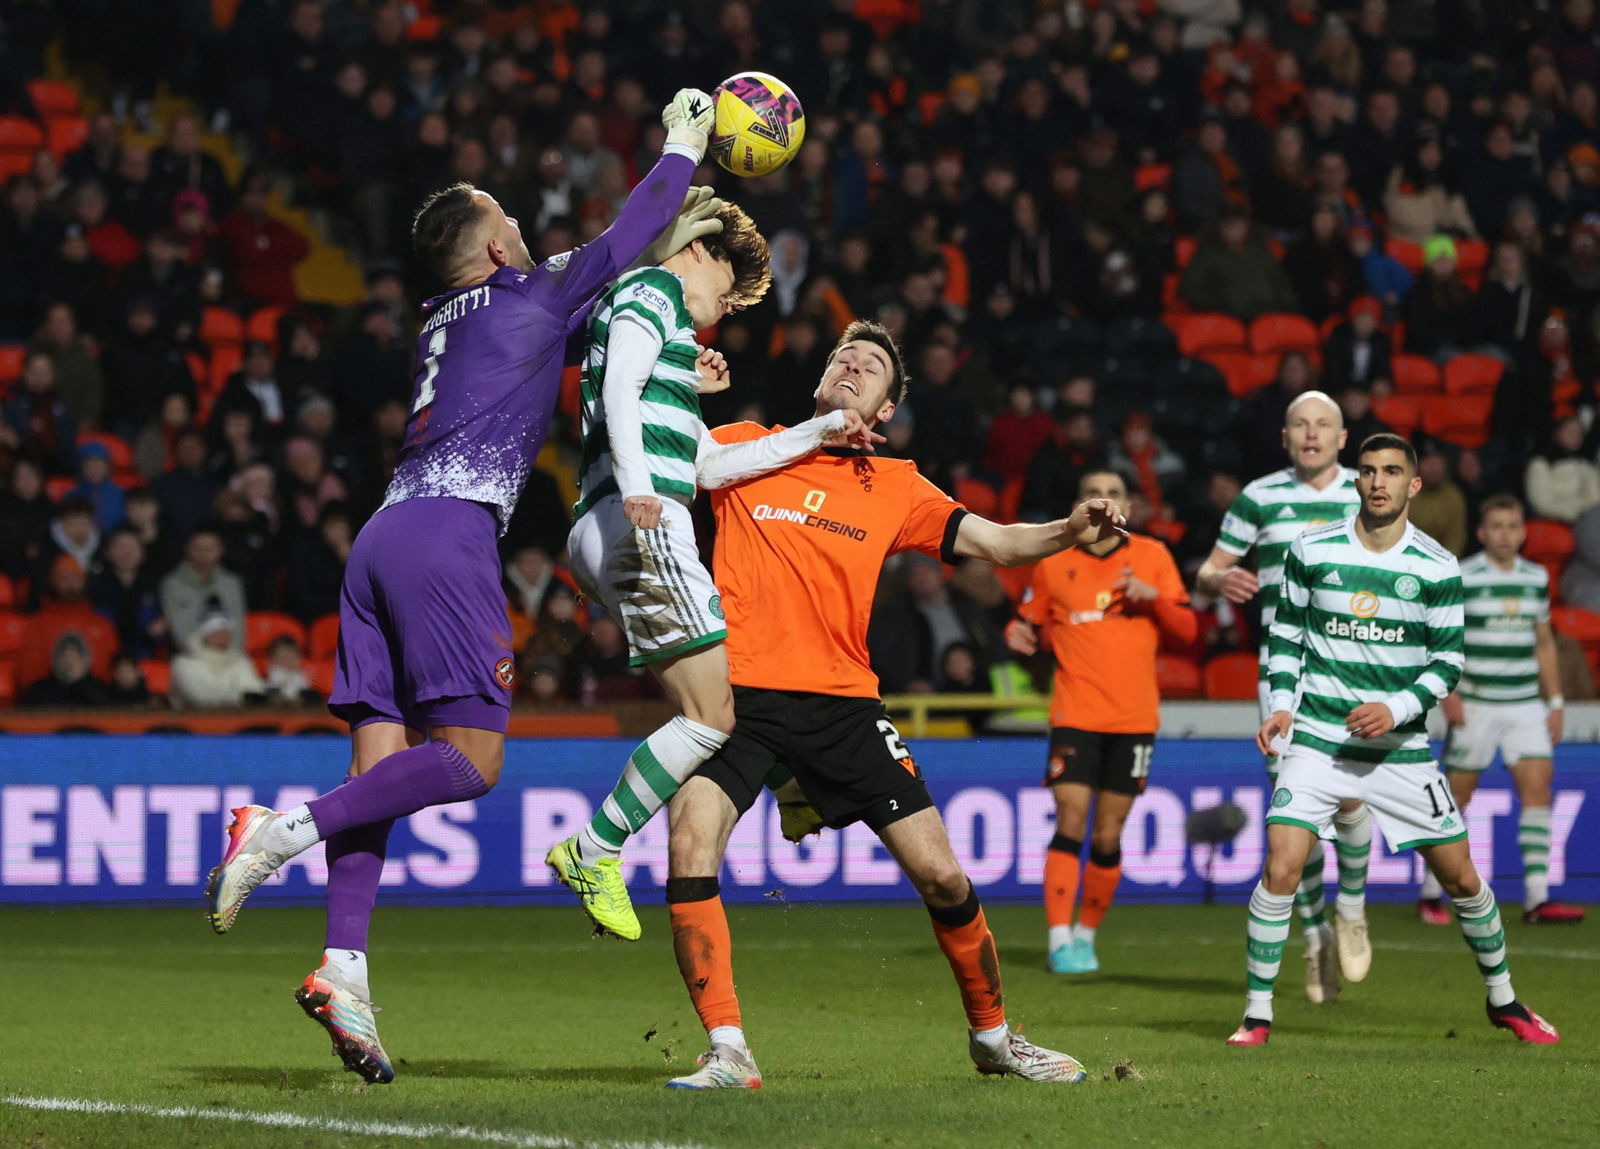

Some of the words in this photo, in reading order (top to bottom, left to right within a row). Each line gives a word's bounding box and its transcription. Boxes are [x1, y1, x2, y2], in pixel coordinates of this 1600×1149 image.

[642, 289, 669, 312] cinch
[413, 326, 447, 413] 1
[1325, 617, 1405, 643] dafabet
[876, 719, 911, 761] 2
[889, 799, 899, 811] 2
[1424, 778, 1456, 818] 11
[2, 785, 480, 887] ENTAS
[1119, 786, 1585, 888] QULTY
